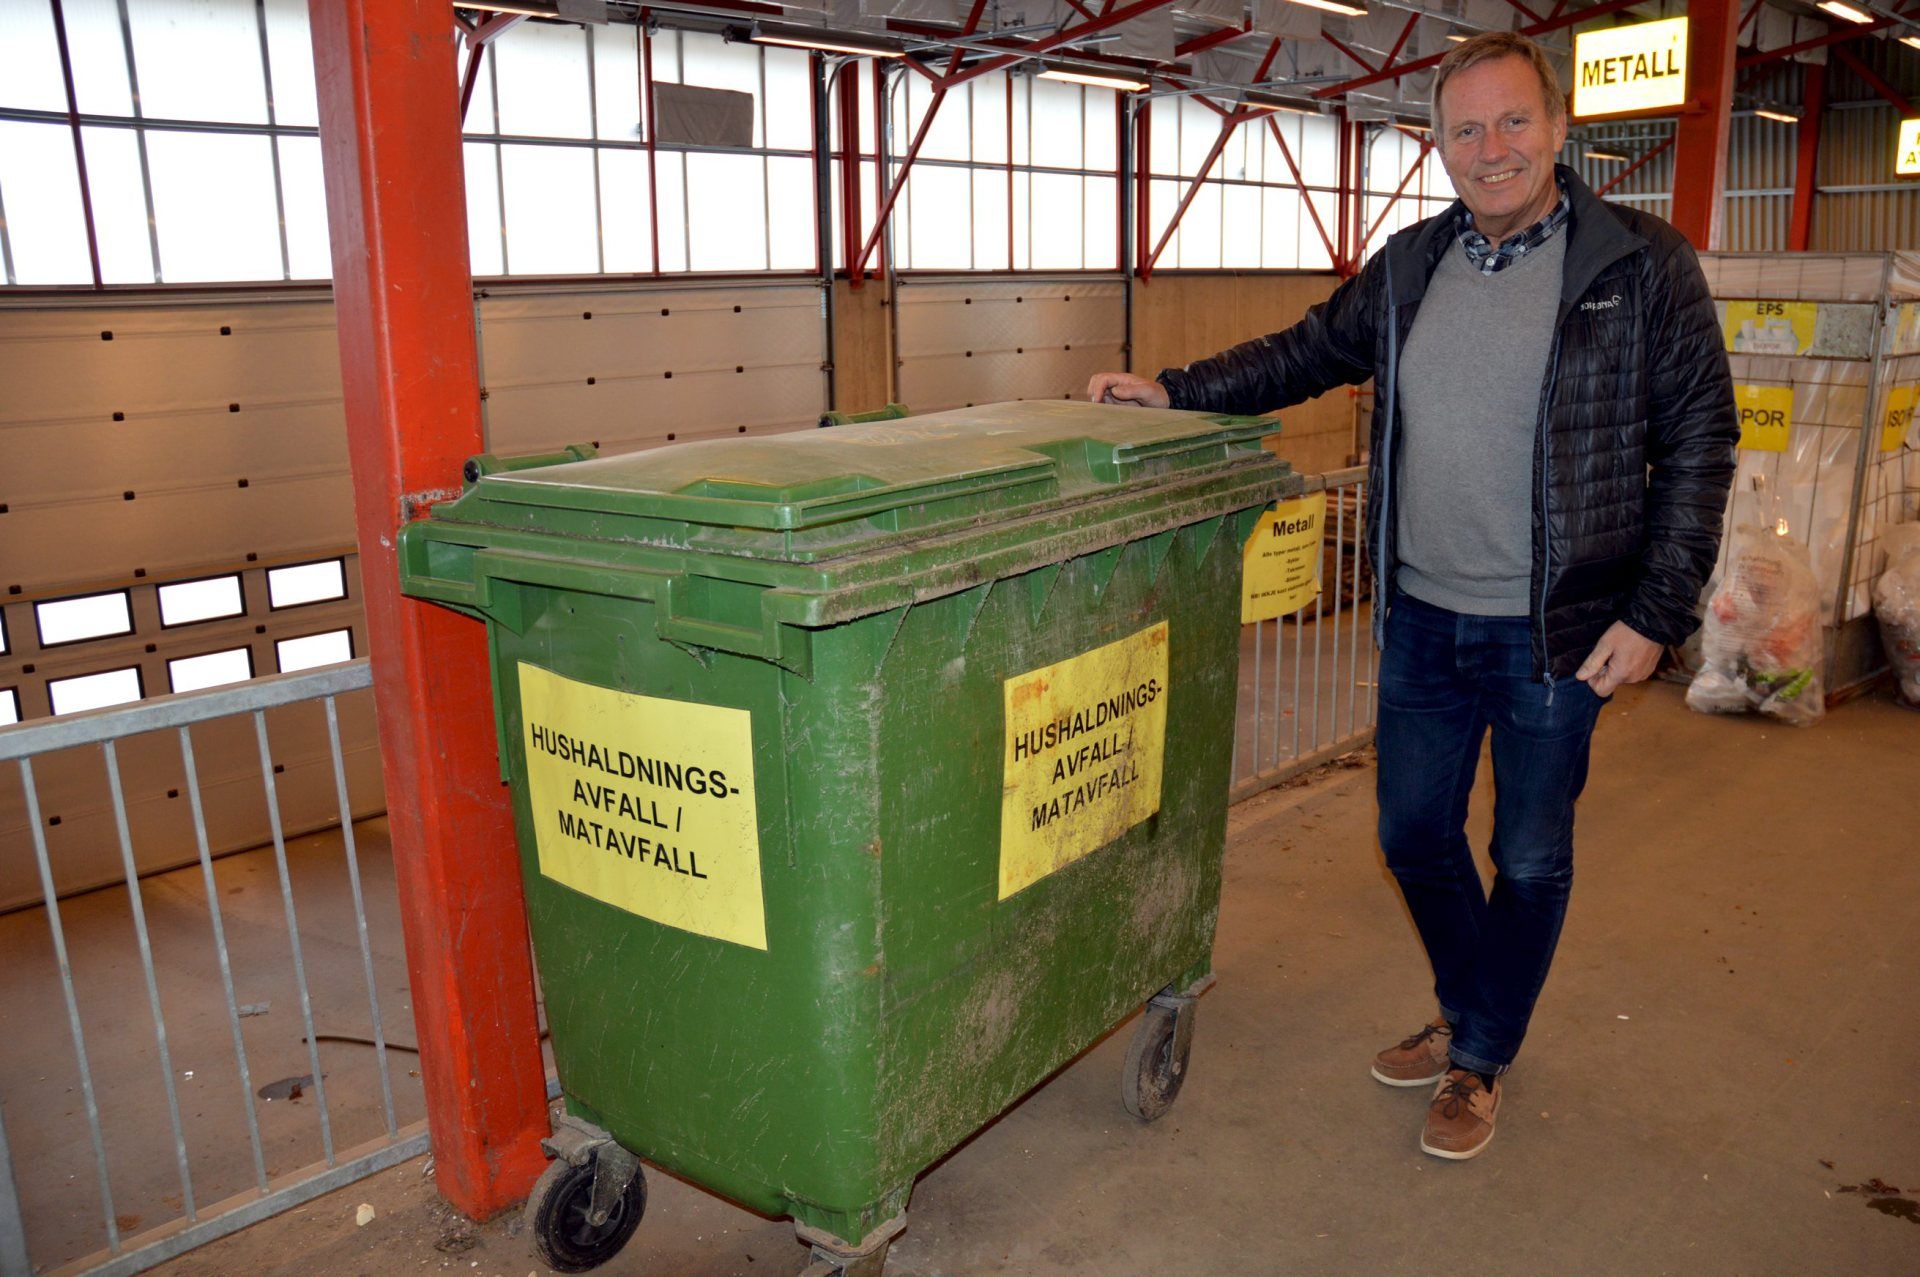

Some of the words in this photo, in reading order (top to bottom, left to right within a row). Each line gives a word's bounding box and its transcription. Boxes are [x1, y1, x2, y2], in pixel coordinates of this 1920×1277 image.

[1582, 49, 1680, 88] METALL
[1756, 303, 1784, 315] EPS
[1738, 408, 1785, 428] POR
[1273, 514, 1314, 536] Metall
[1015, 678, 1163, 762] HUSHALDNINGS-
[531, 723, 740, 799] HUSHALDNINGS-
[1052, 732, 1122, 784] AVFALL
[573, 778, 668, 829] AVFALL
[1031, 760, 1140, 831] MATAVFALL
[558, 809, 708, 879] MATAVFALL
